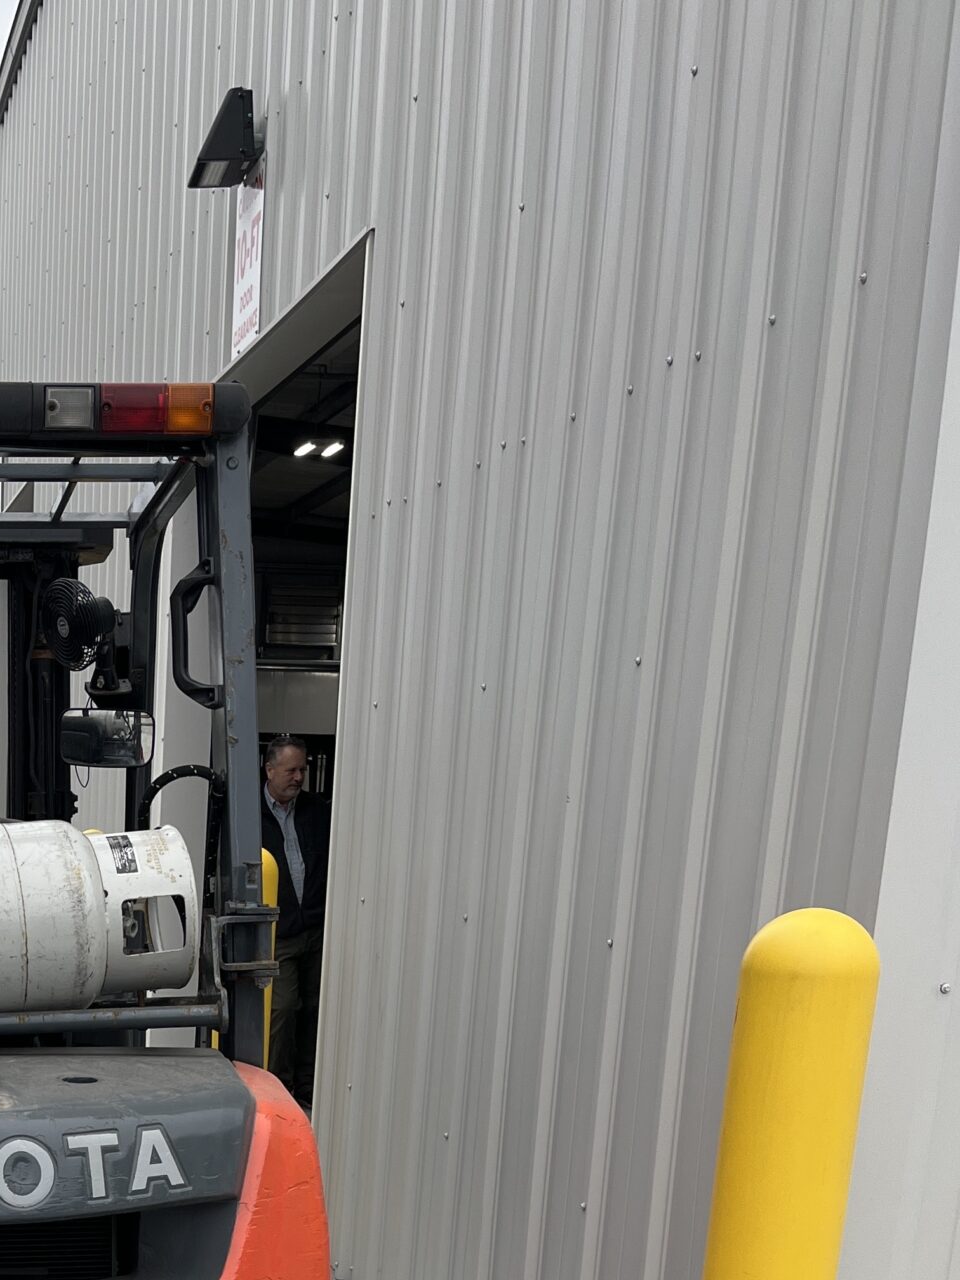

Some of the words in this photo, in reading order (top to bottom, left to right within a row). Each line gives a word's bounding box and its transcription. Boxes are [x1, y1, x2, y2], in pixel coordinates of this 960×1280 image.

[236, 210, 262, 285] 10-FT
[240, 283, 253, 314] DOOR
[233, 307, 258, 348] CLEARANCE
